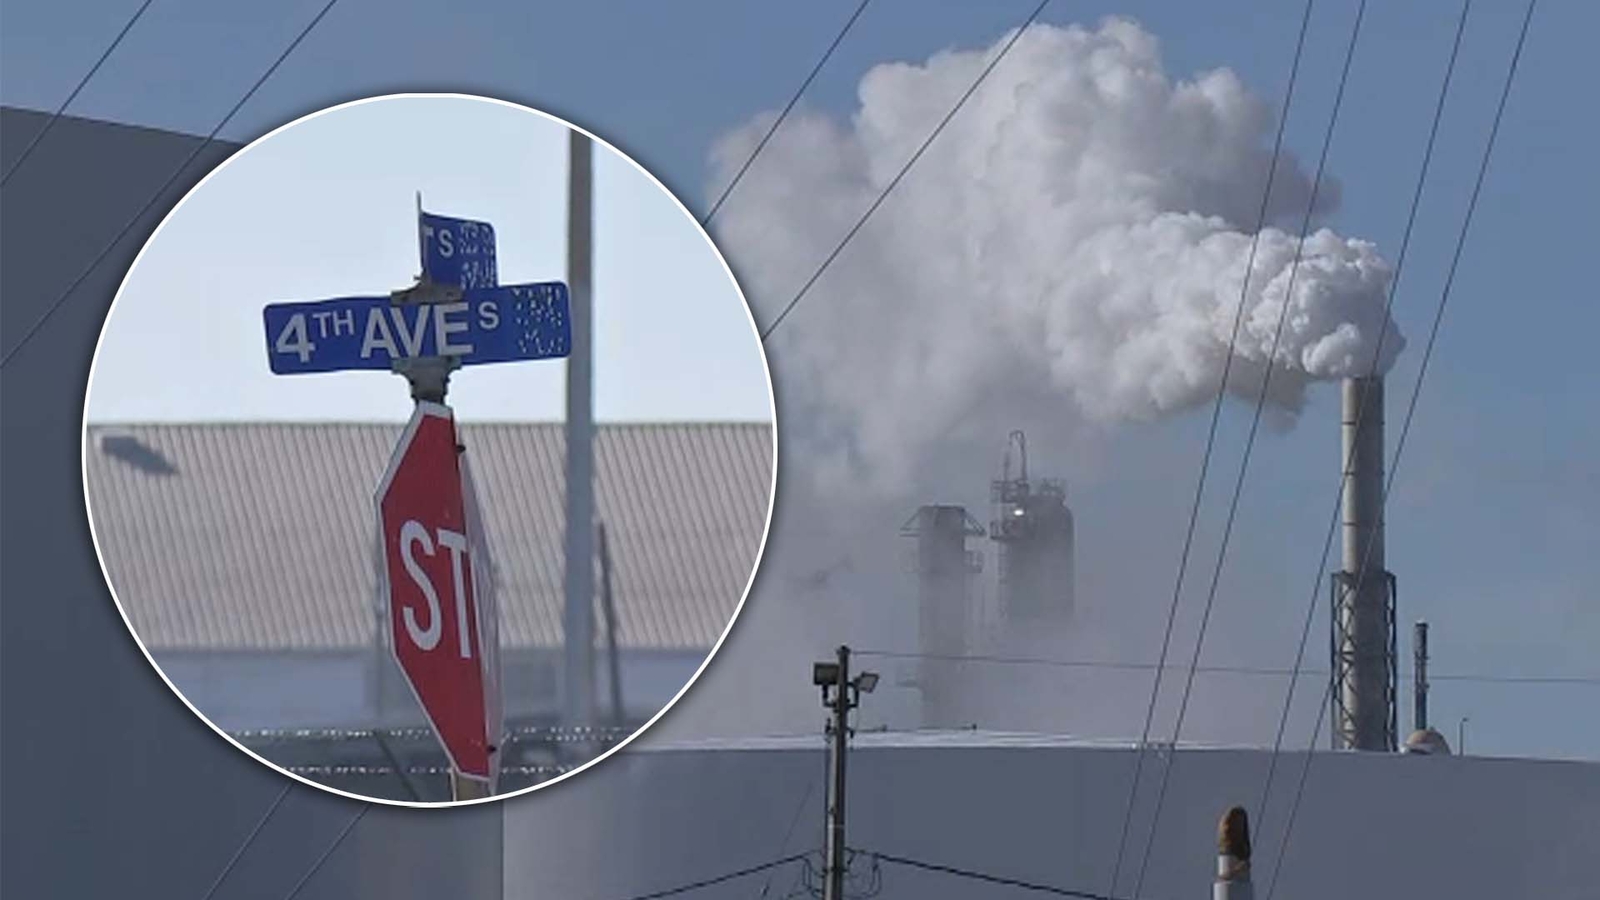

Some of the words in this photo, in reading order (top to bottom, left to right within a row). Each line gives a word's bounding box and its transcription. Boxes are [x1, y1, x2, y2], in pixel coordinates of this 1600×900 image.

[439, 228, 454, 258] S
[275, 309, 354, 364] 4TH
[360, 301, 473, 360] AVE
[478, 301, 499, 330] S
[400, 519, 477, 659] ST
